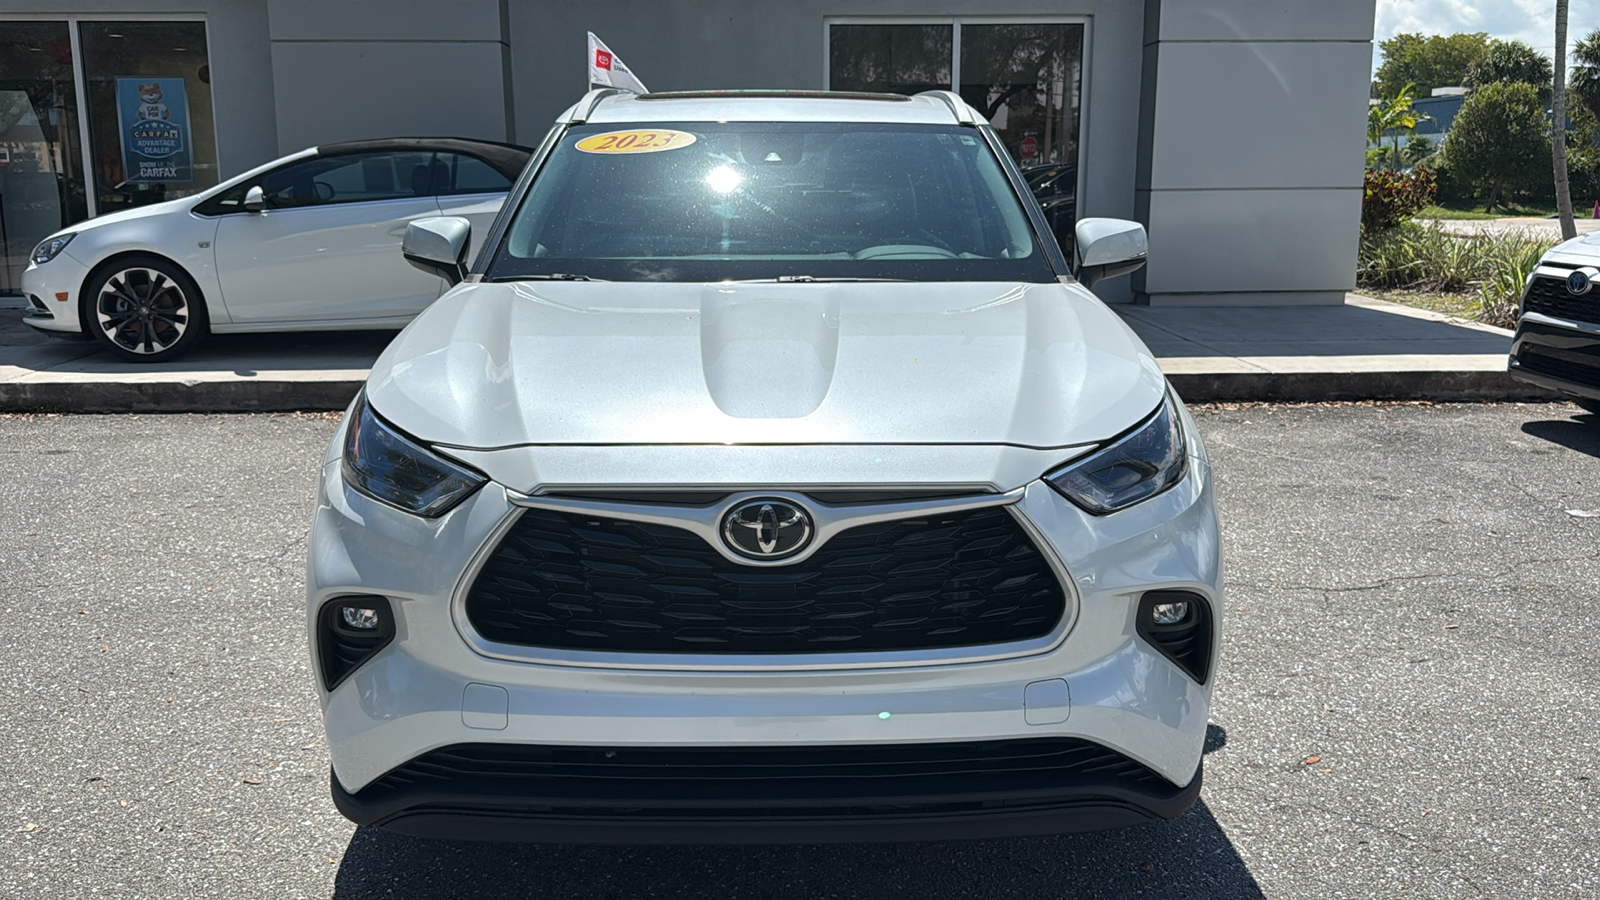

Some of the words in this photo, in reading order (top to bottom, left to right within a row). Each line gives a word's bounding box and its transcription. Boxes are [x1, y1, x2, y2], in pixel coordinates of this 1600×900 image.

[133, 130, 178, 139] CARFAX
[594, 133, 677, 150] 2023
[140, 168, 177, 178] CARFAX
